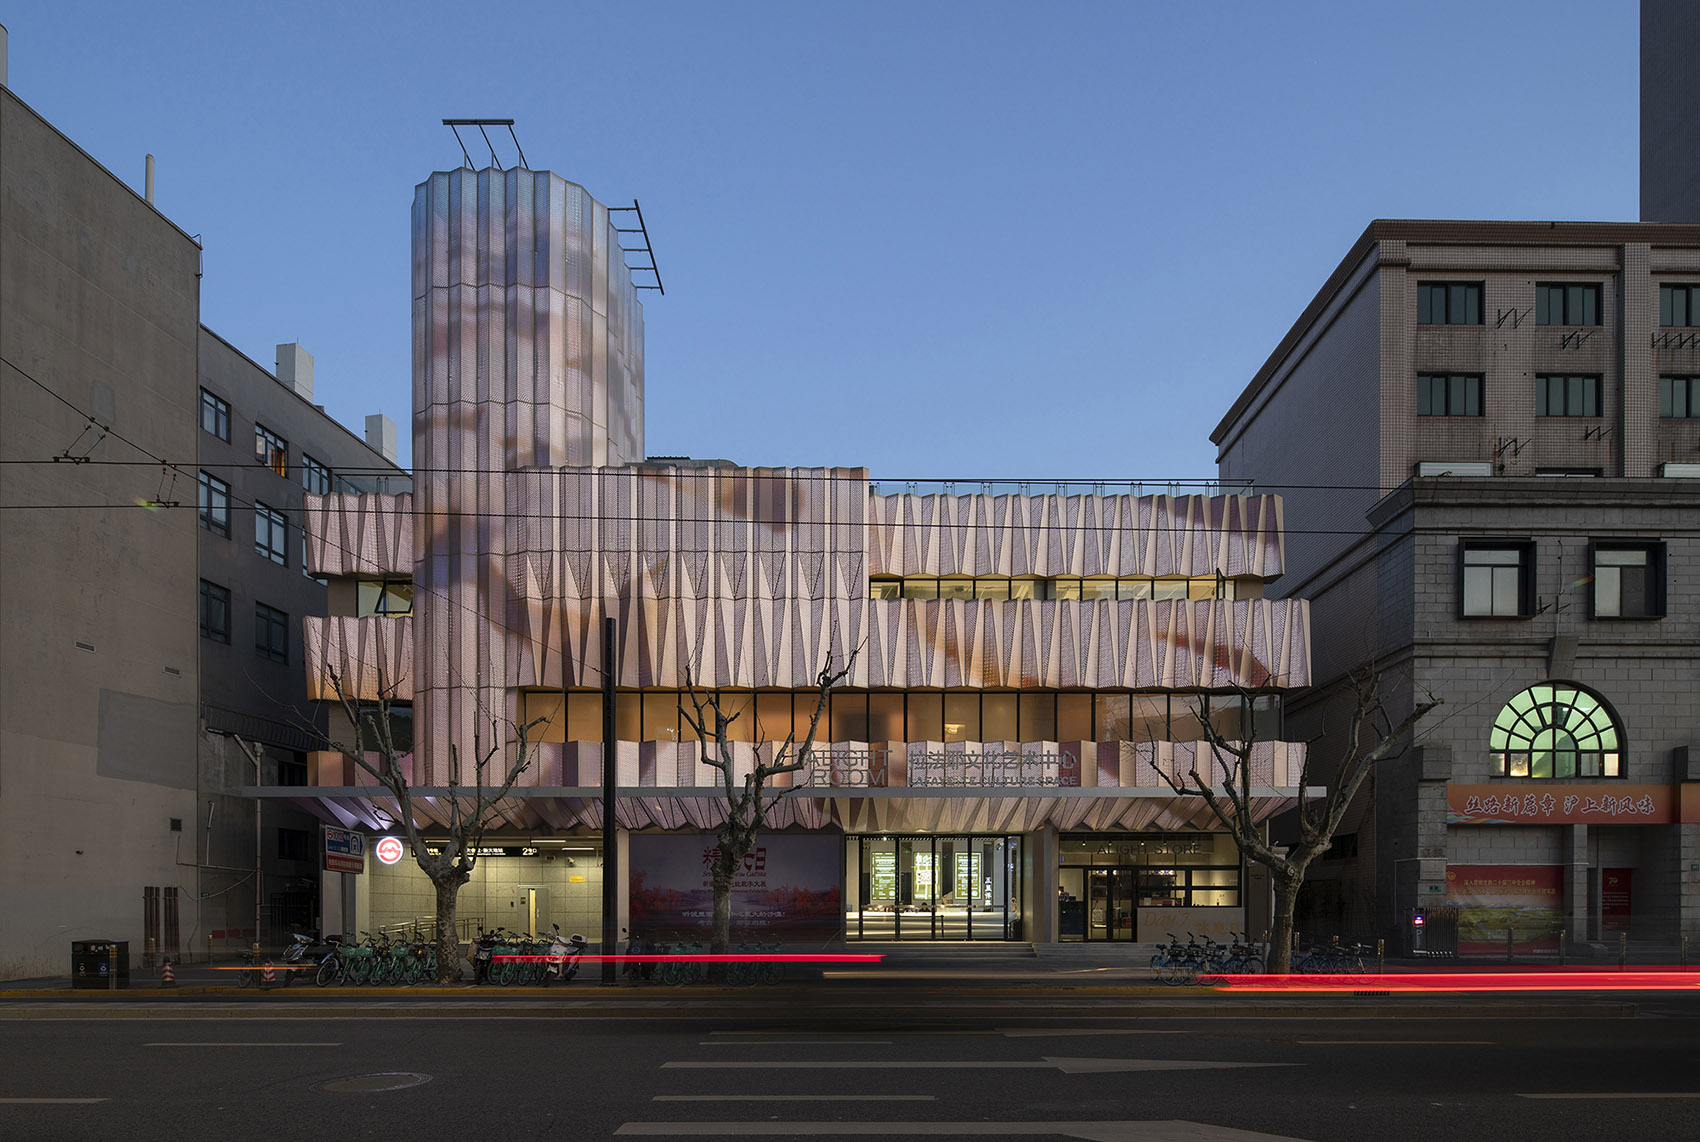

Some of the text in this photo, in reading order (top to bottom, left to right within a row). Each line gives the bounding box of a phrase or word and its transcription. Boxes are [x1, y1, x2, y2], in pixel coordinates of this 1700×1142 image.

[804, 750, 893, 767] ALIGHT
[910, 749, 1077, 770] 拉法耶文化艺术中心
[811, 768, 886, 786] ROOM
[909, 776, 1077, 785] LAFAYETTE CULTURE SPACE
[1464, 793, 1656, 816] 丝路新篇章 沪上新风味
[703, 846, 766, 870] 精七日
[1097, 844, 1201, 855] ALIGHT STORE
